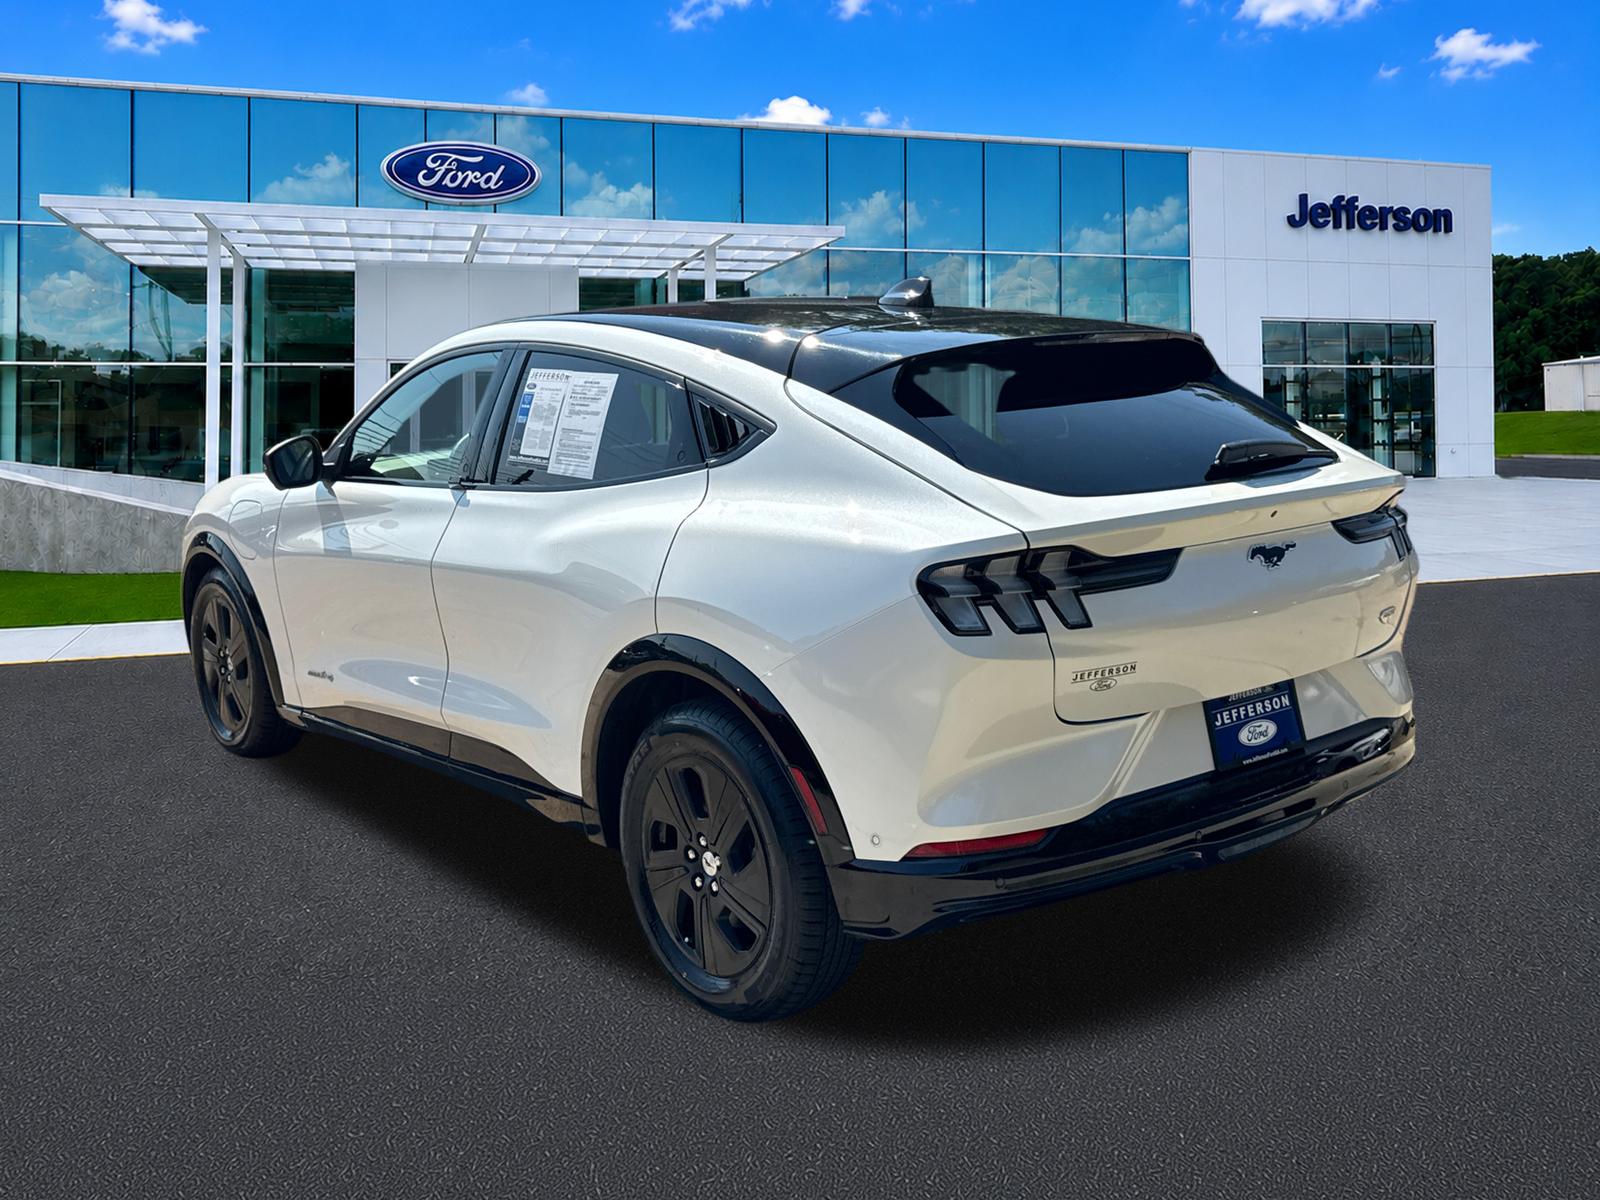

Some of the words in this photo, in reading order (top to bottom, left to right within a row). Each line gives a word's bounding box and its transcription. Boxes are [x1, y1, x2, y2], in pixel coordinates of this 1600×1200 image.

[417, 152, 505, 189] Ford
[1286, 193, 1453, 233] Jefferson
[530, 371, 570, 380] JEFFERSON
[1072, 663, 1137, 681] JEFFERSON
[1214, 694, 1290, 727] JEFFERSON
[1246, 724, 1269, 742] Ford
